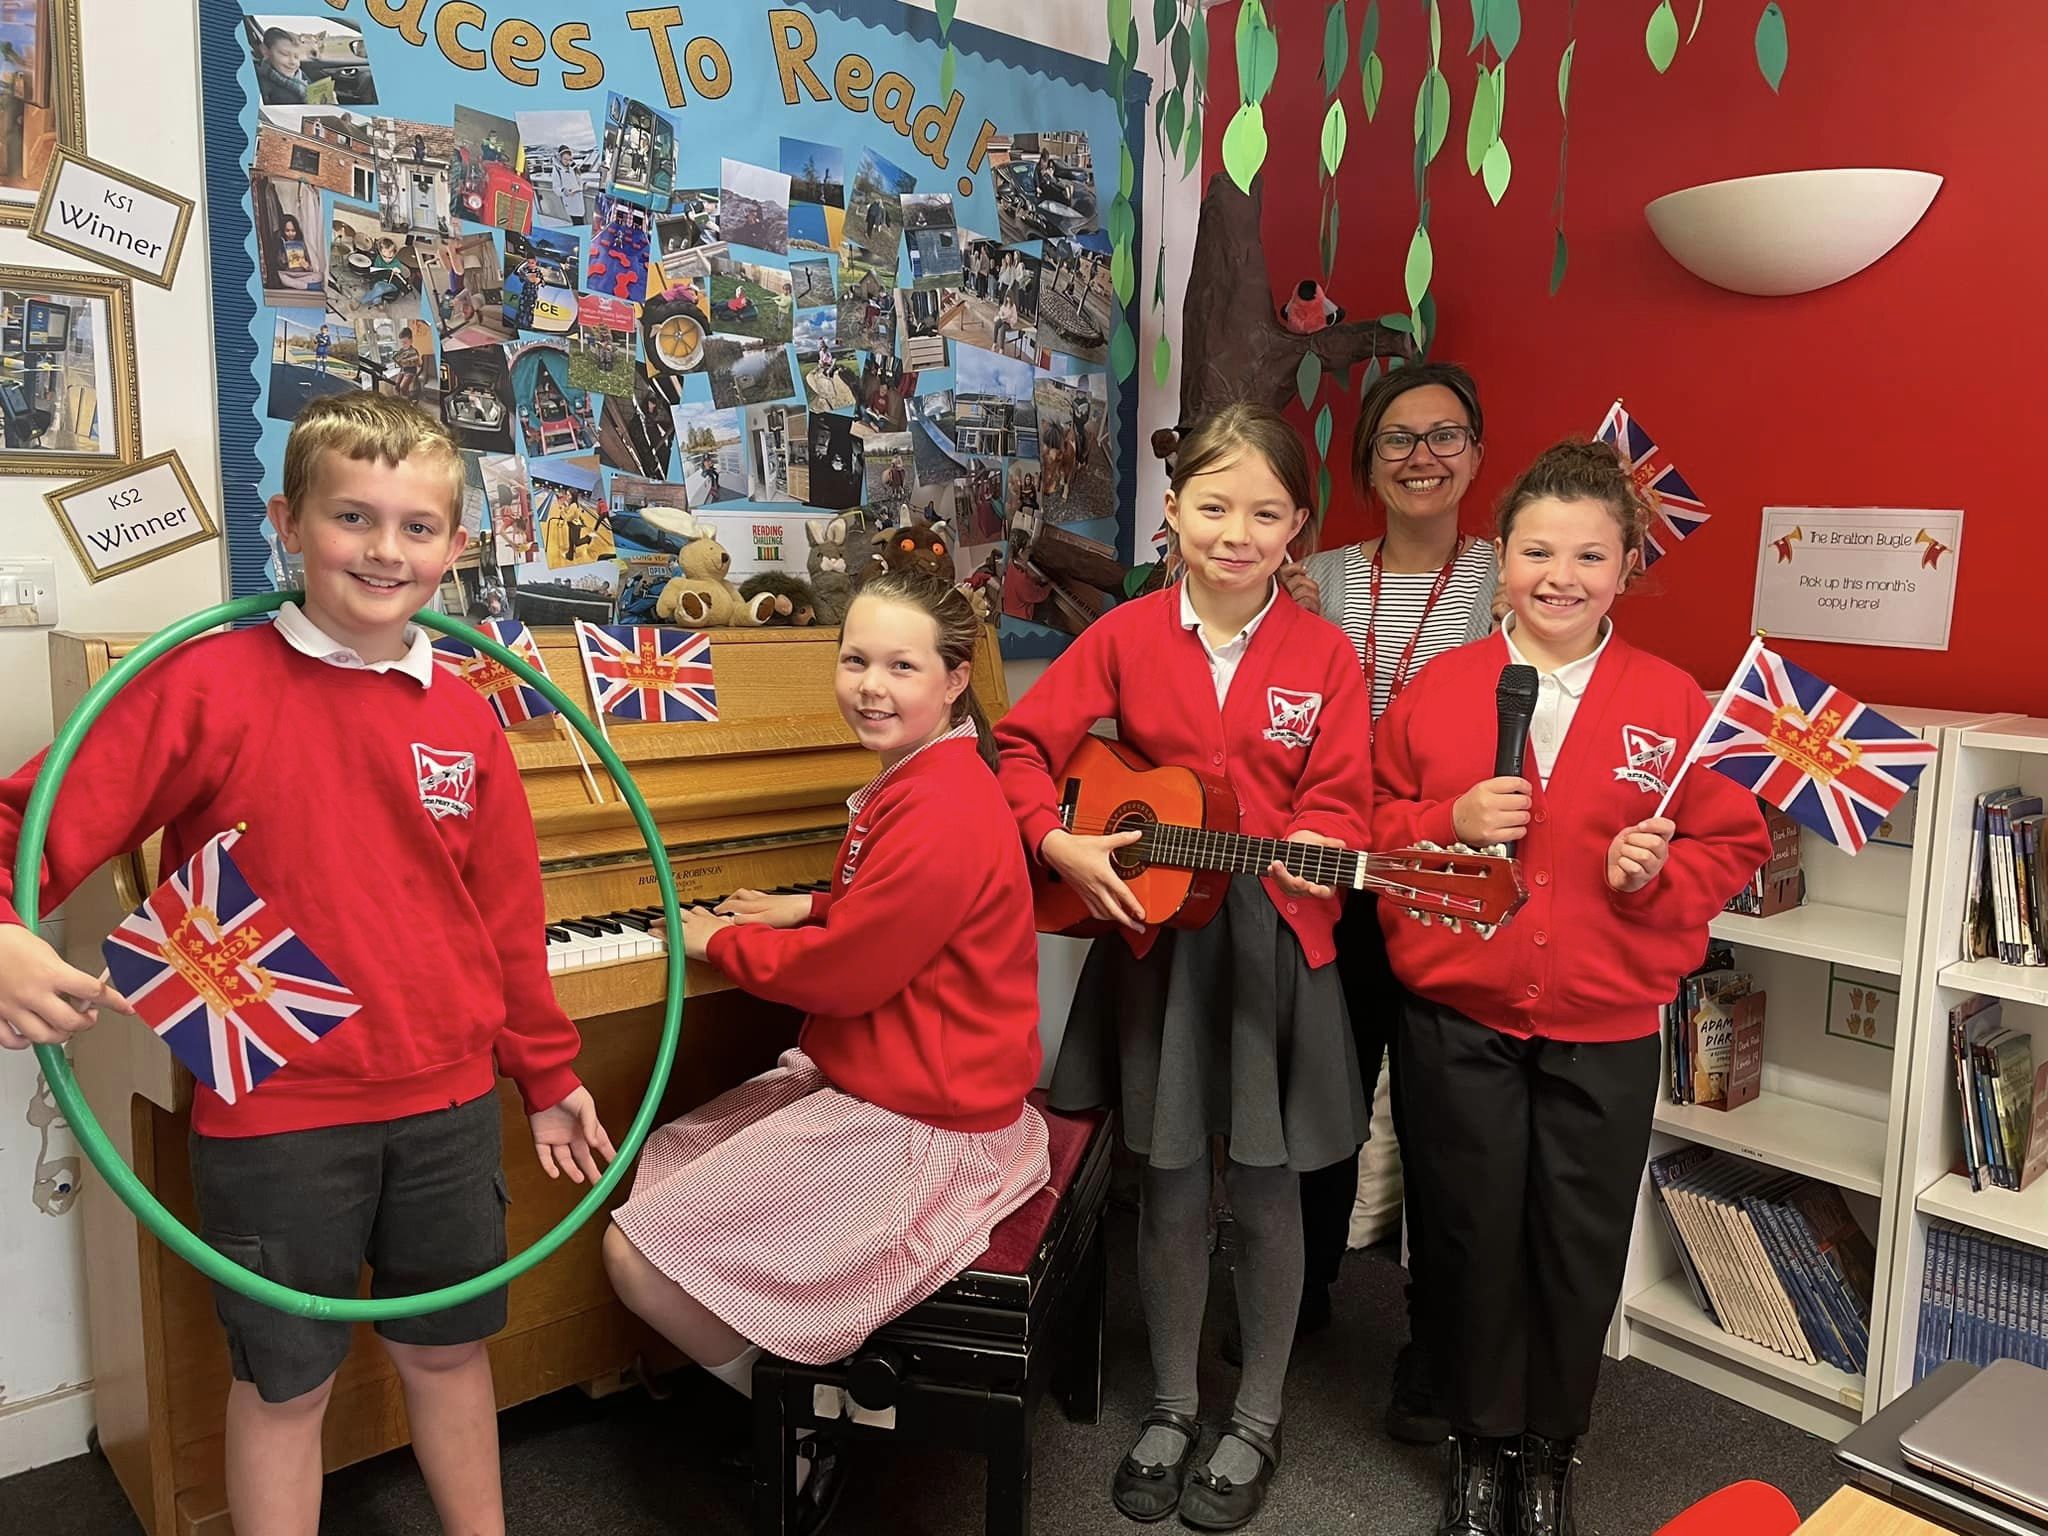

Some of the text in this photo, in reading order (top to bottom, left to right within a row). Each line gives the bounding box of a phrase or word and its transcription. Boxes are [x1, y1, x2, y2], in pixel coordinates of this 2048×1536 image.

[324, 0, 997, 197] aces To Read!
[103, 188, 134, 214] KS1
[60, 199, 162, 261] Winner
[108, 487, 142, 511] KS2
[88, 503, 188, 554] Winner
[752, 525, 784, 537] READING
[1810, 531, 1913, 549] The Bratton Bugle
[1800, 575, 1917, 593] Pick up this month's
[1818, 597, 1881, 610] copy here!
[683, 865, 722, 878] ROBINSON
